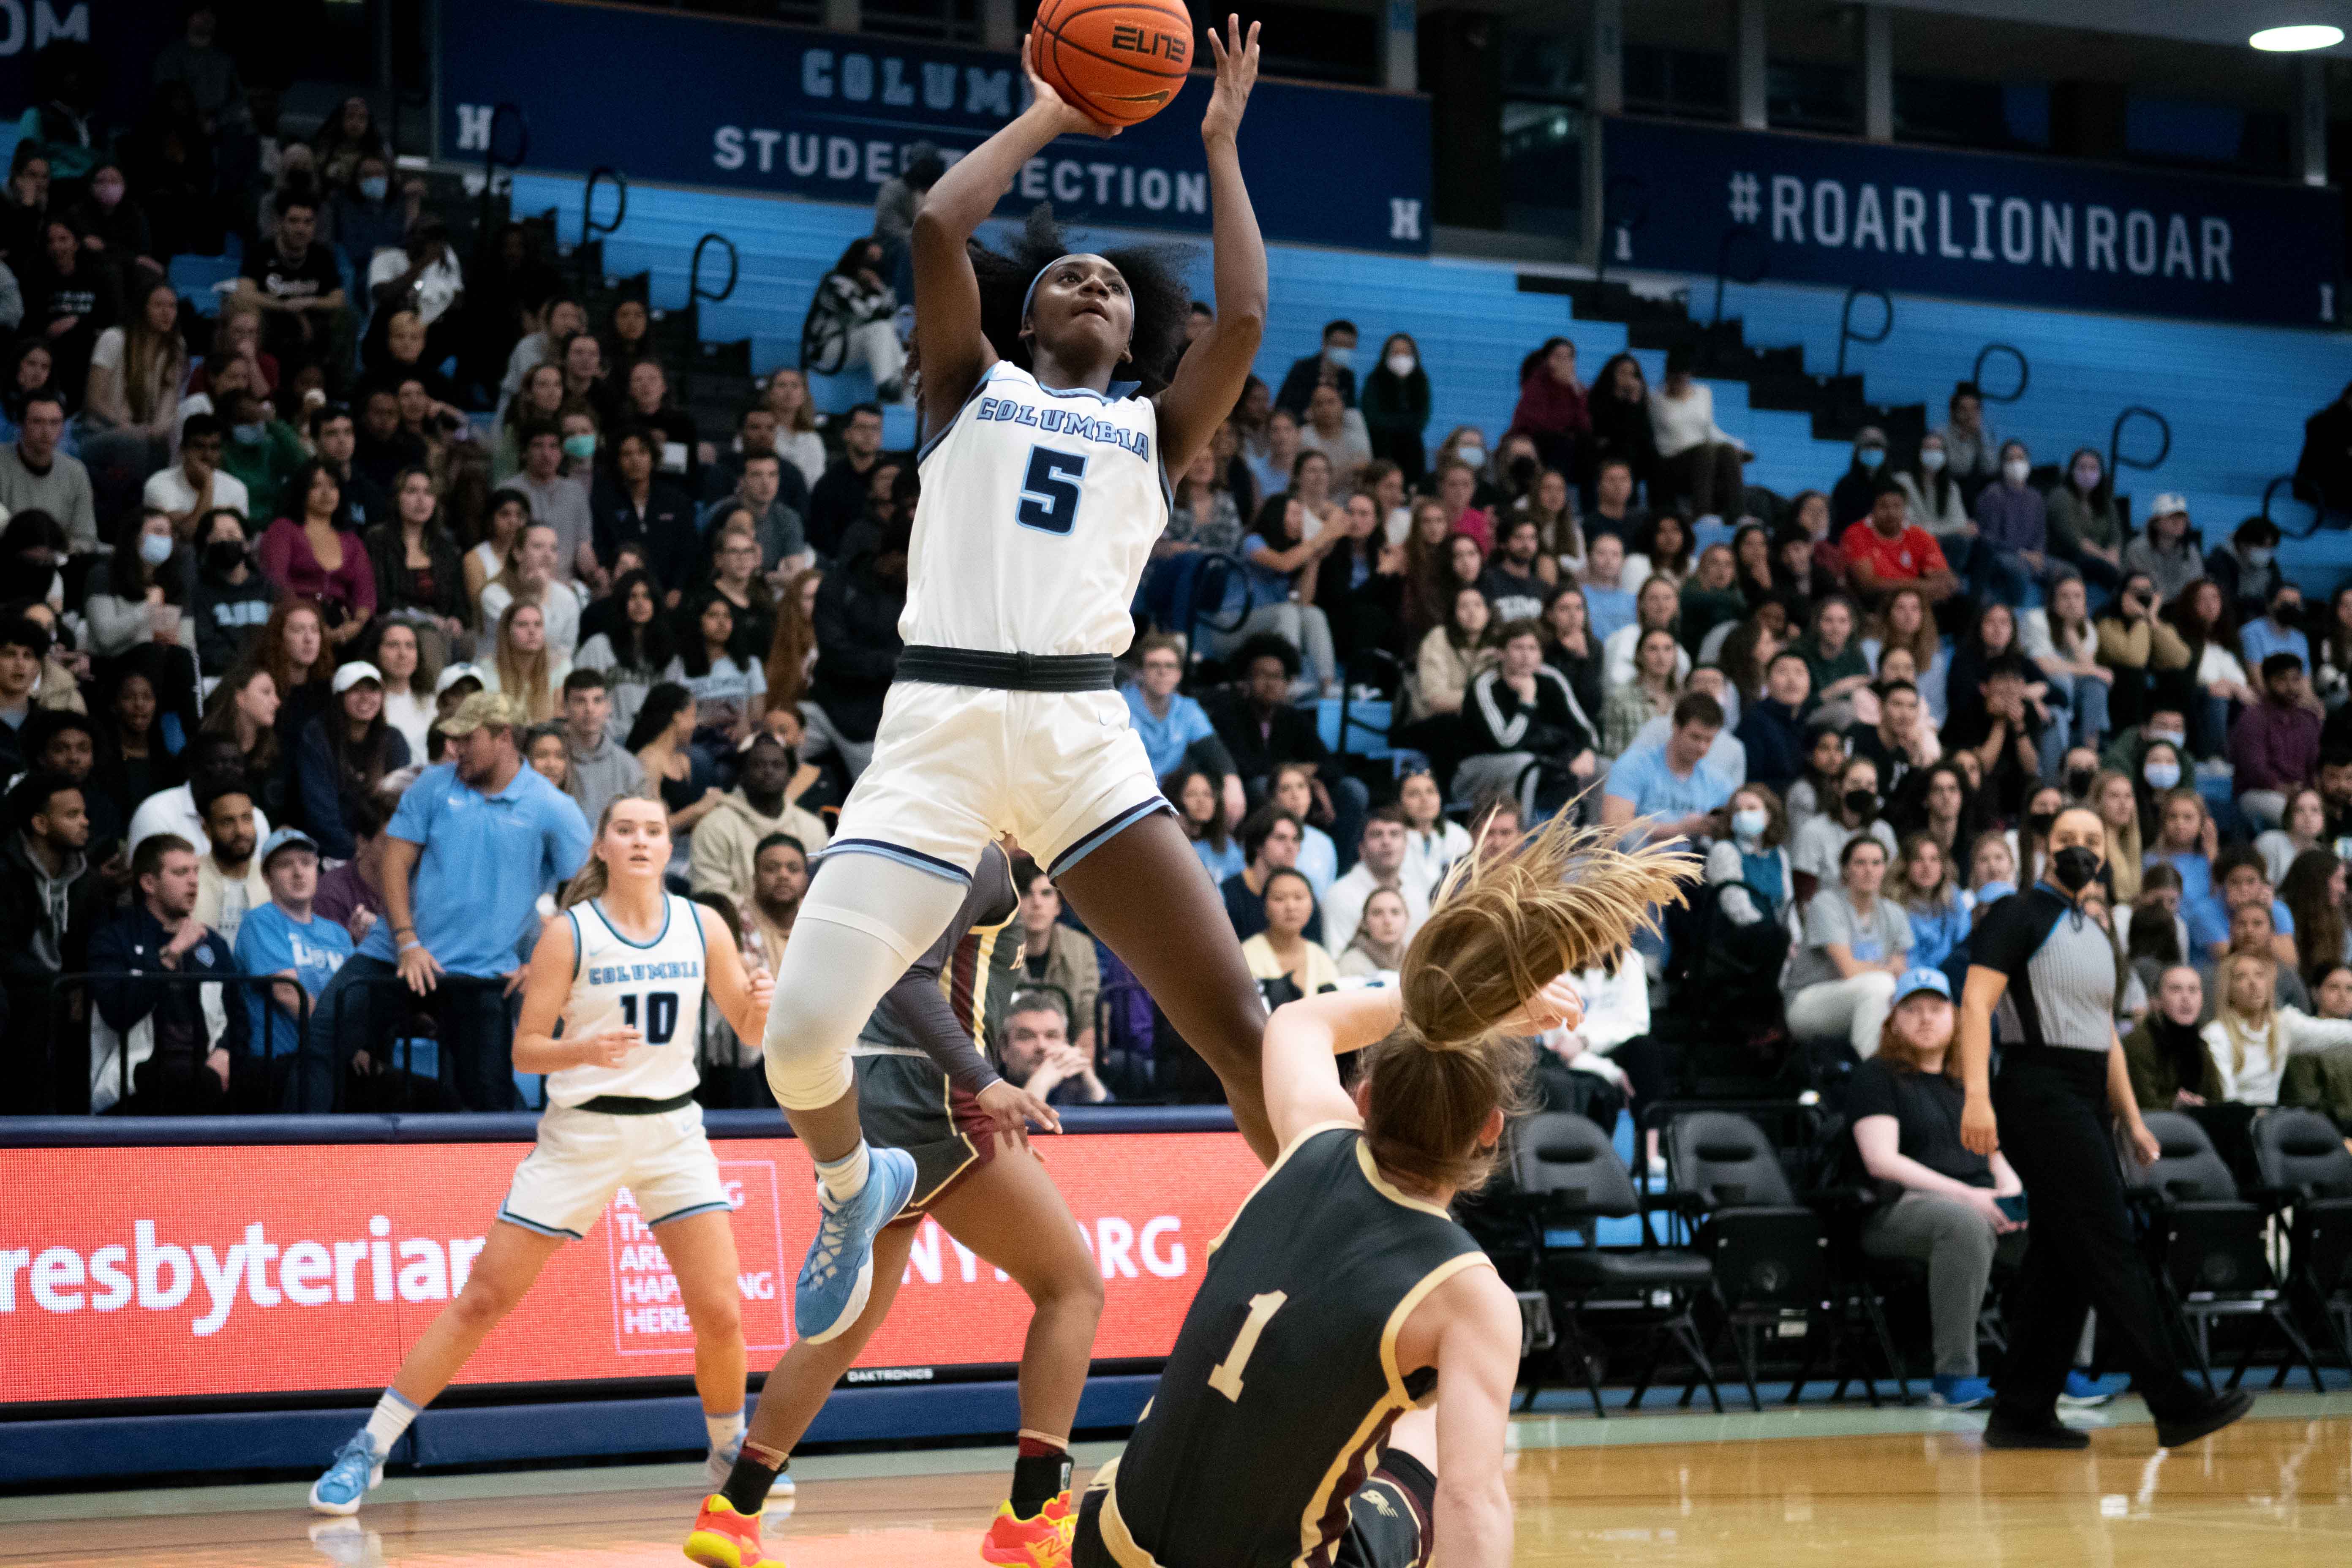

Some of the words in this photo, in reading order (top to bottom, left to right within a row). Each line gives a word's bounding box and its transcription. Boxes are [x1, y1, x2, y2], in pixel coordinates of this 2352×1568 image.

[1112, 25, 1186, 63] ELITE
[1021, 157, 1207, 215] ECTION
[1390, 198, 1421, 240] H
[1728, 171, 2233, 283] #ROARLIONROAR
[976, 397, 1149, 463] COLUMBIA
[1015, 443, 1089, 536] 5
[589, 960, 699, 985] COLUMBIA
[619, 991, 678, 1045] 10
[623, 1307, 692, 1334] HERE
[1207, 1290, 1288, 1403] 1
[847, 1368, 934, 1382] DAKTRONICS
